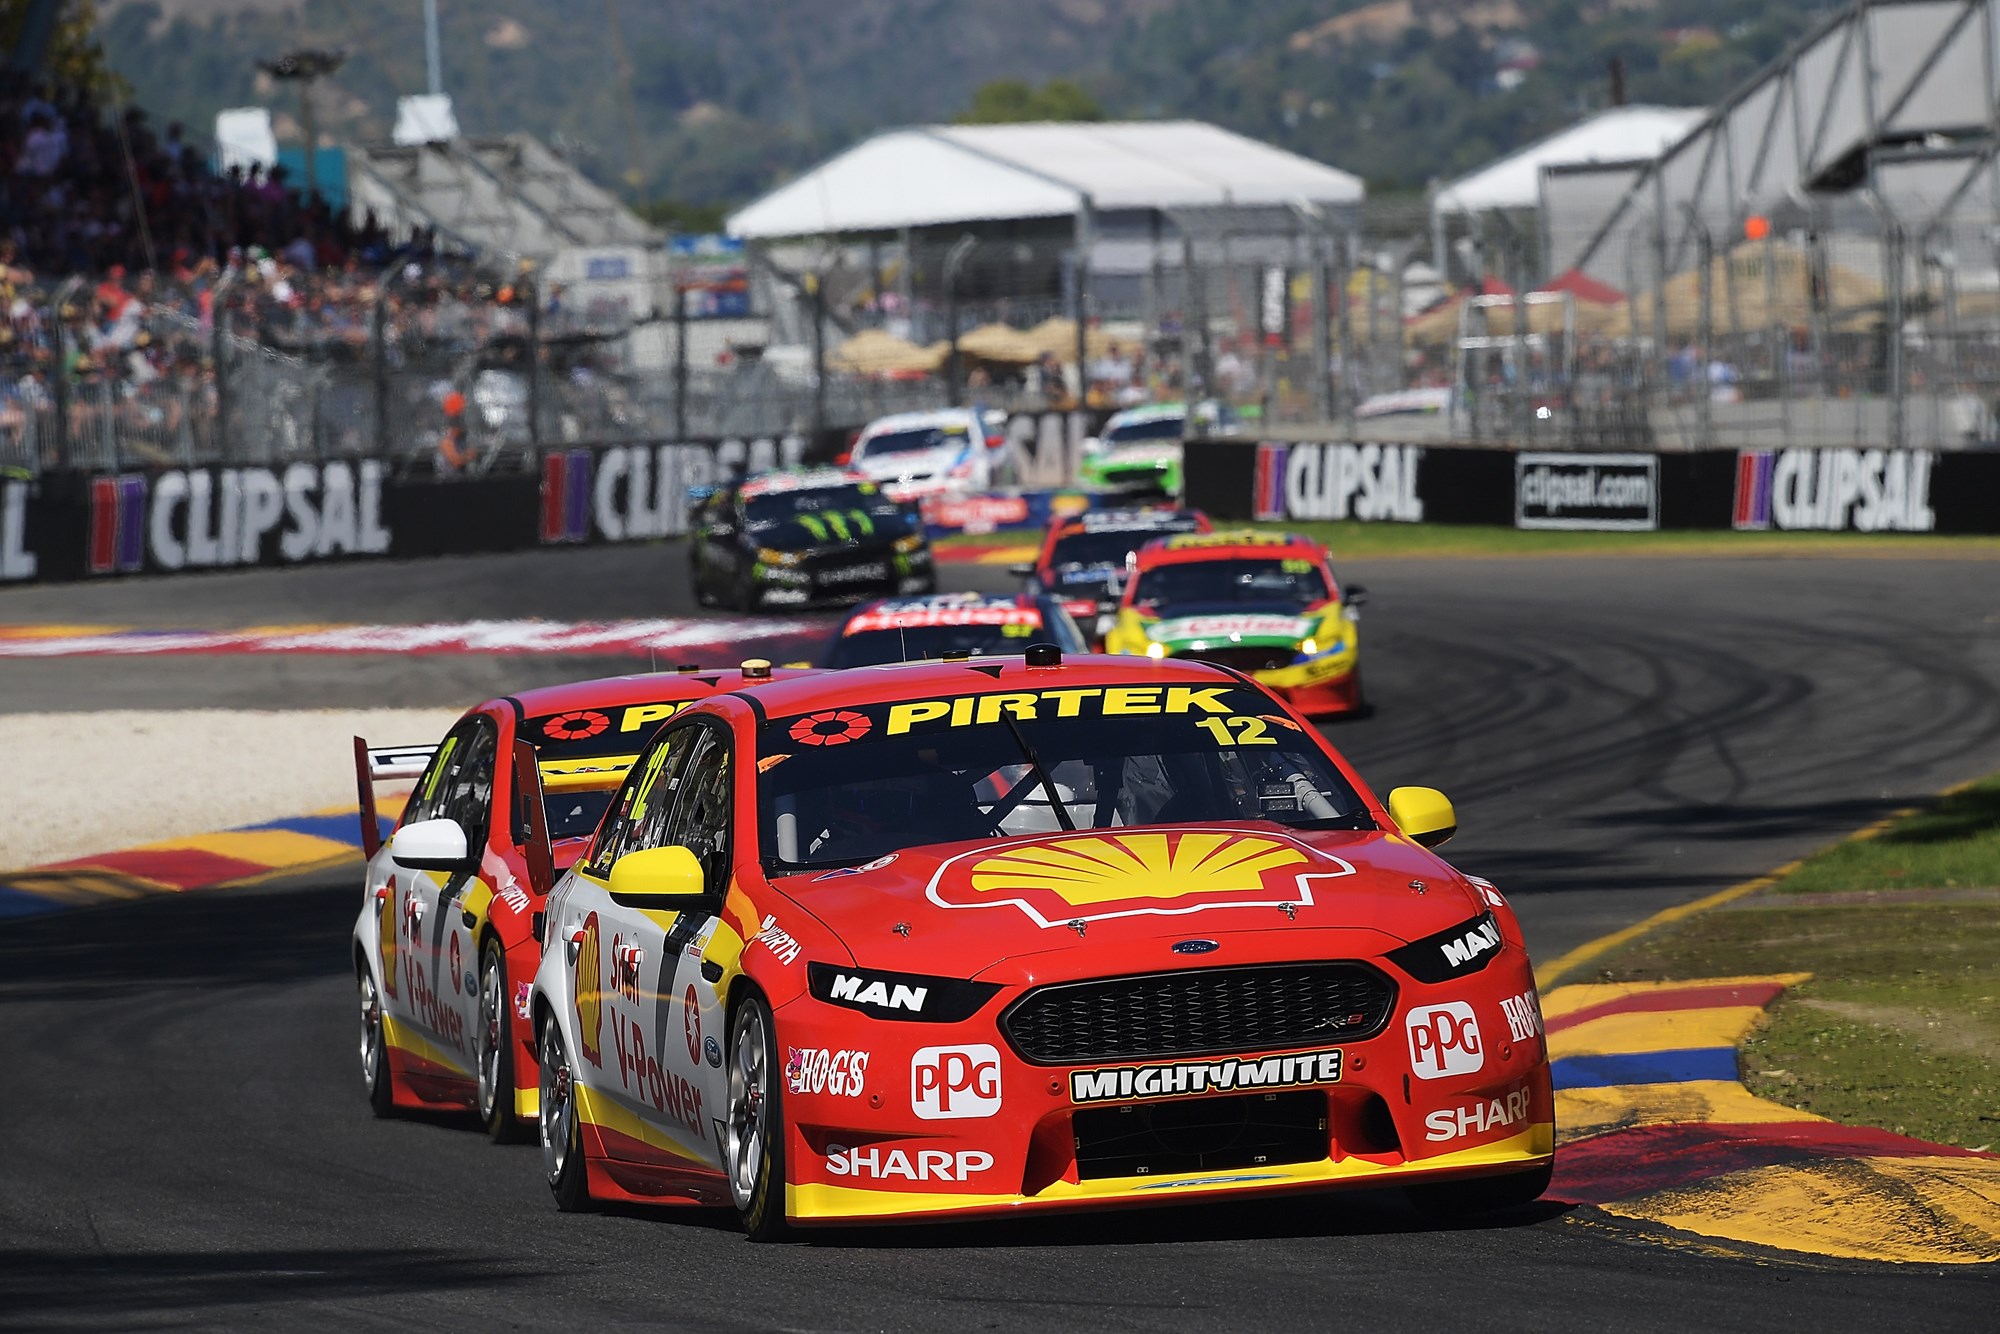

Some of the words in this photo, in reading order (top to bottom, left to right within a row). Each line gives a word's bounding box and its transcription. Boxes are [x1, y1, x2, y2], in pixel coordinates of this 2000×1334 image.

[1286, 442, 1423, 521] CLIPSAL
[1523, 466, 1649, 515] clipsal.com
[1773, 448, 1935, 532] CLIPSAL
[149, 459, 391, 568] CLIPSAL
[887, 687, 1235, 735] PIRTEK
[1195, 716, 1278, 746] 12
[1441, 920, 1500, 967] MAN
[830, 974, 927, 1012] MAN
[1410, 1010, 1480, 1071] PPG
[610, 1005, 706, 1141] V-Power
[800, 1048, 871, 1097] HOG'S
[916, 1053, 997, 1112] PPG
[1425, 1086, 1532, 1142] SHARP
[825, 1143, 995, 1181] SHARP
